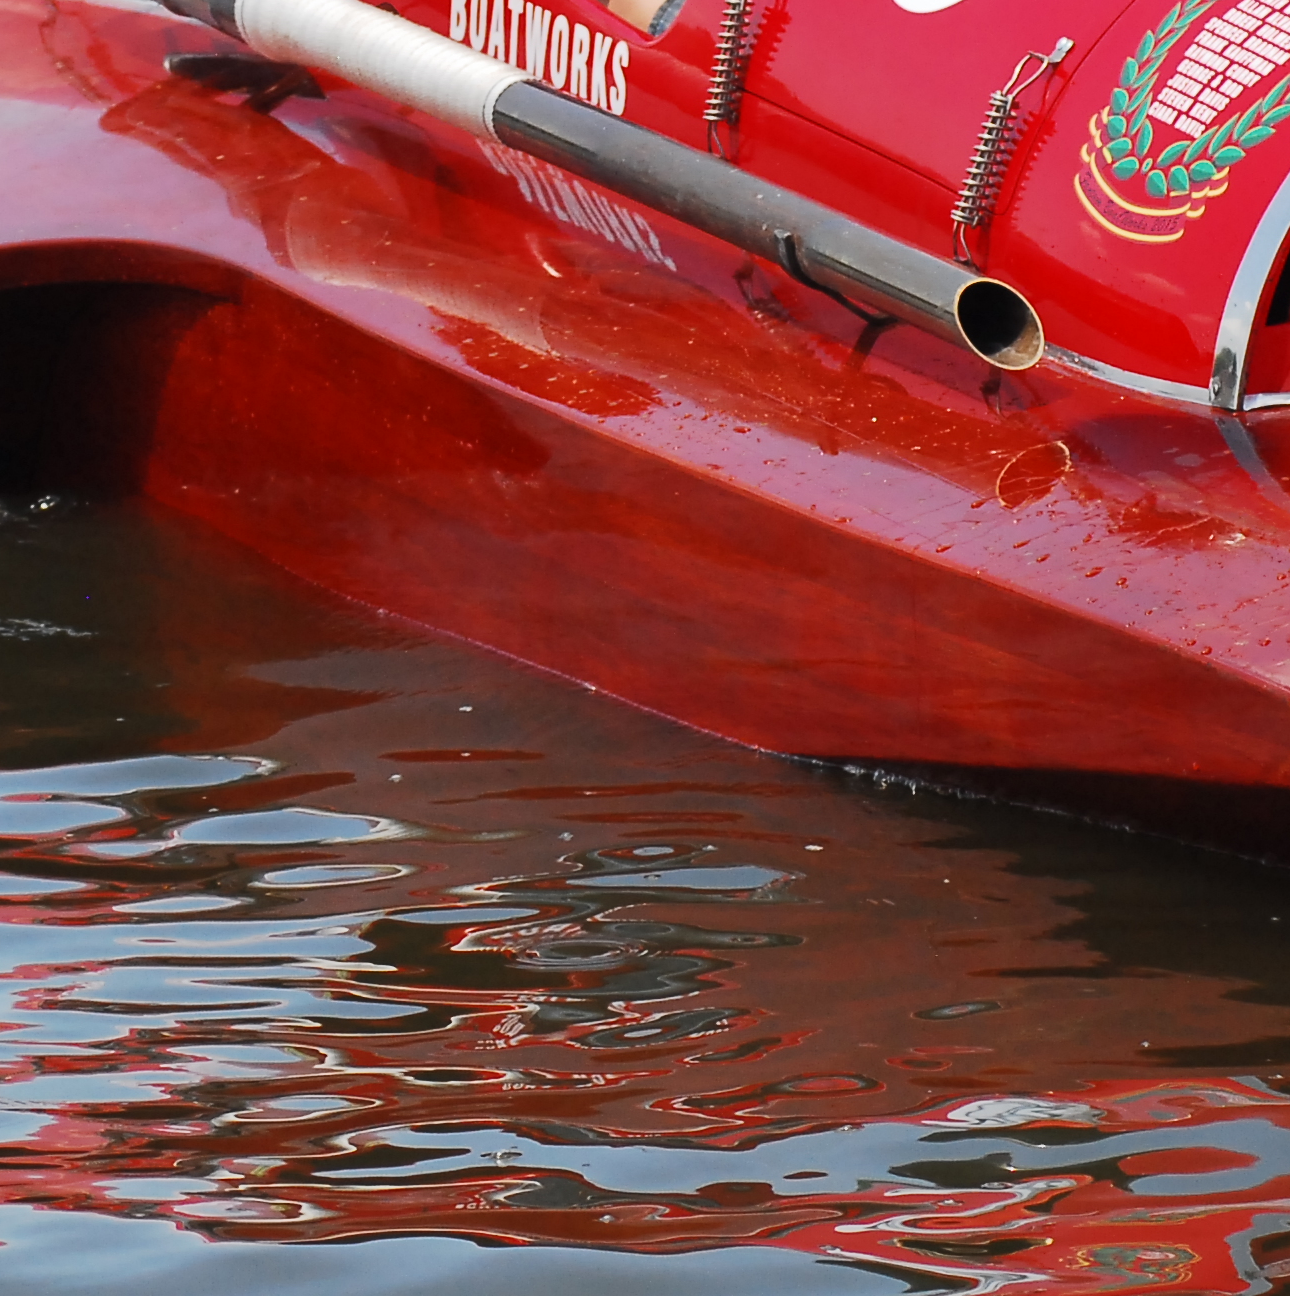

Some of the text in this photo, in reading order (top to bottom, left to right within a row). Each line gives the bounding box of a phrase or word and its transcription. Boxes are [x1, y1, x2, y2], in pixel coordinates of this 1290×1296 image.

[1205, 18, 1248, 44] SPENCER
[1195, 31, 1275, 76] FRANK KAUFFMAN
[1177, 59, 1215, 84] GEORGE
[1158, 88, 1217, 124] STEVEN KENT
[1167, 74, 1229, 110] JUSTIN DAVIS
[1175, 115, 1205, 138] DAVIS
